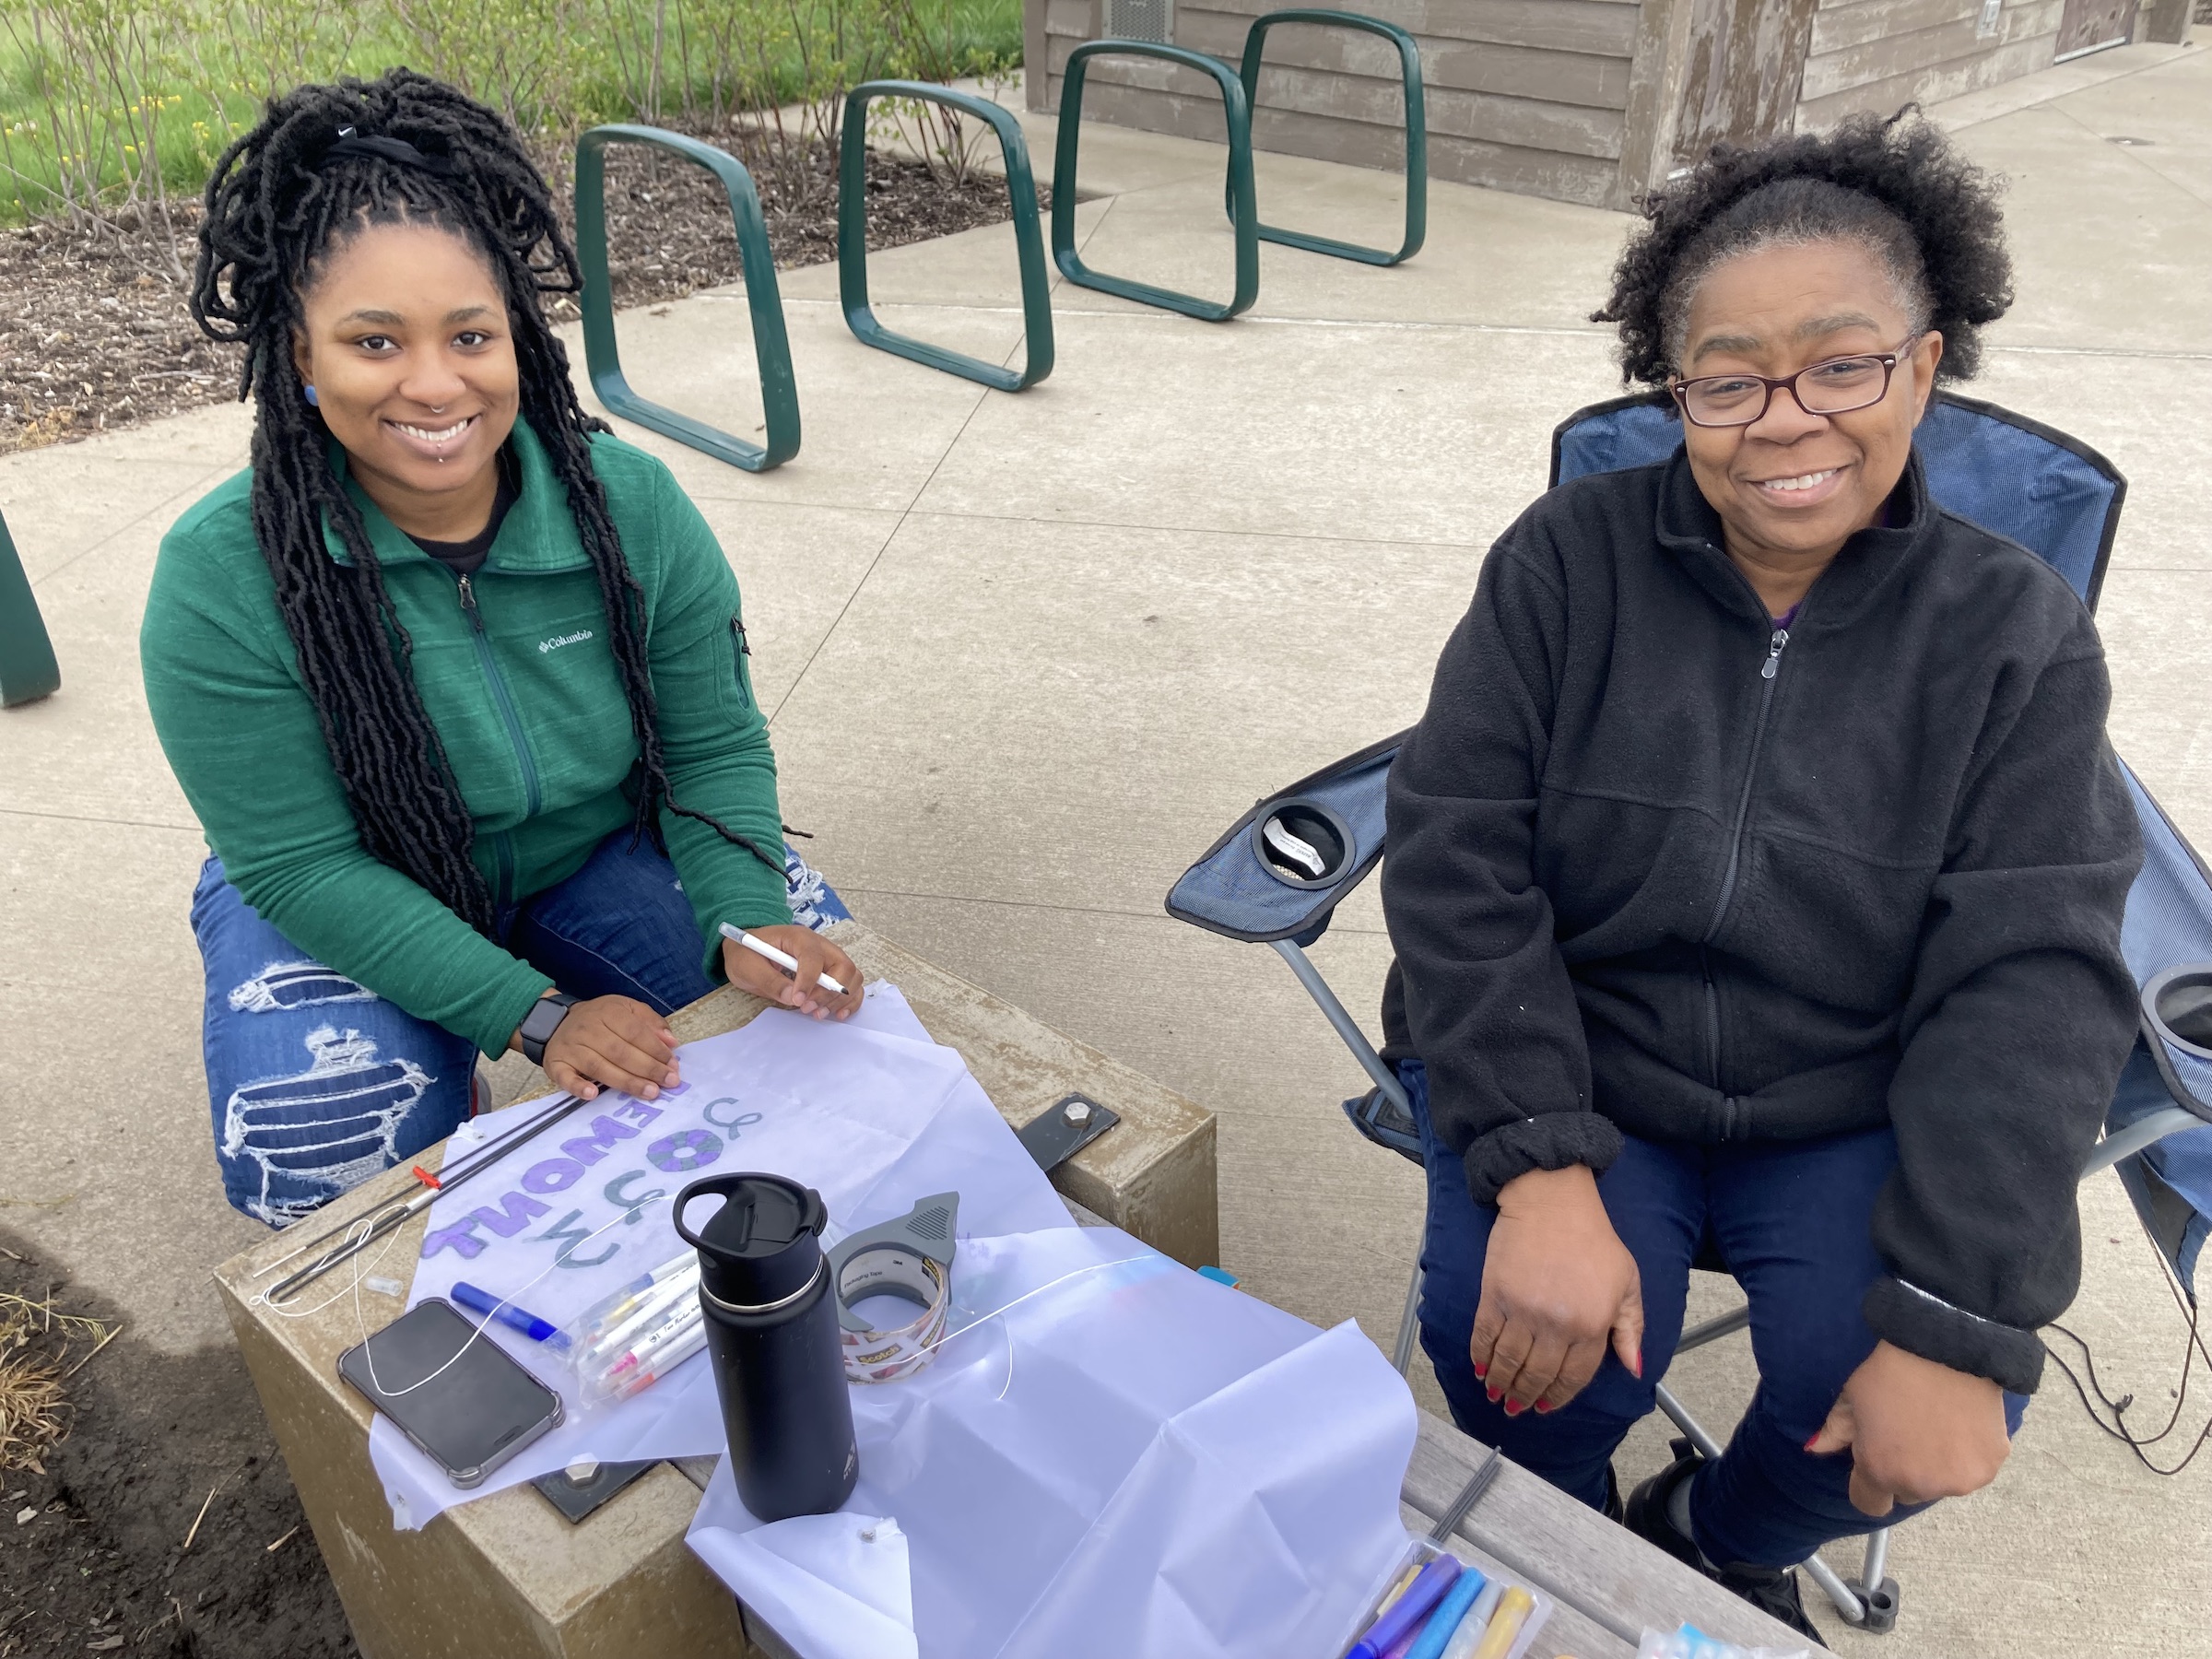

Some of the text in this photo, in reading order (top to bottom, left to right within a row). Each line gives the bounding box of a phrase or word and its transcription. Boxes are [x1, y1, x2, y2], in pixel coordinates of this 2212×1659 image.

[548, 629, 594, 650] Columbia
[843, 1272, 869, 1288] Packaging
[860, 1347, 900, 1363] Scotch
